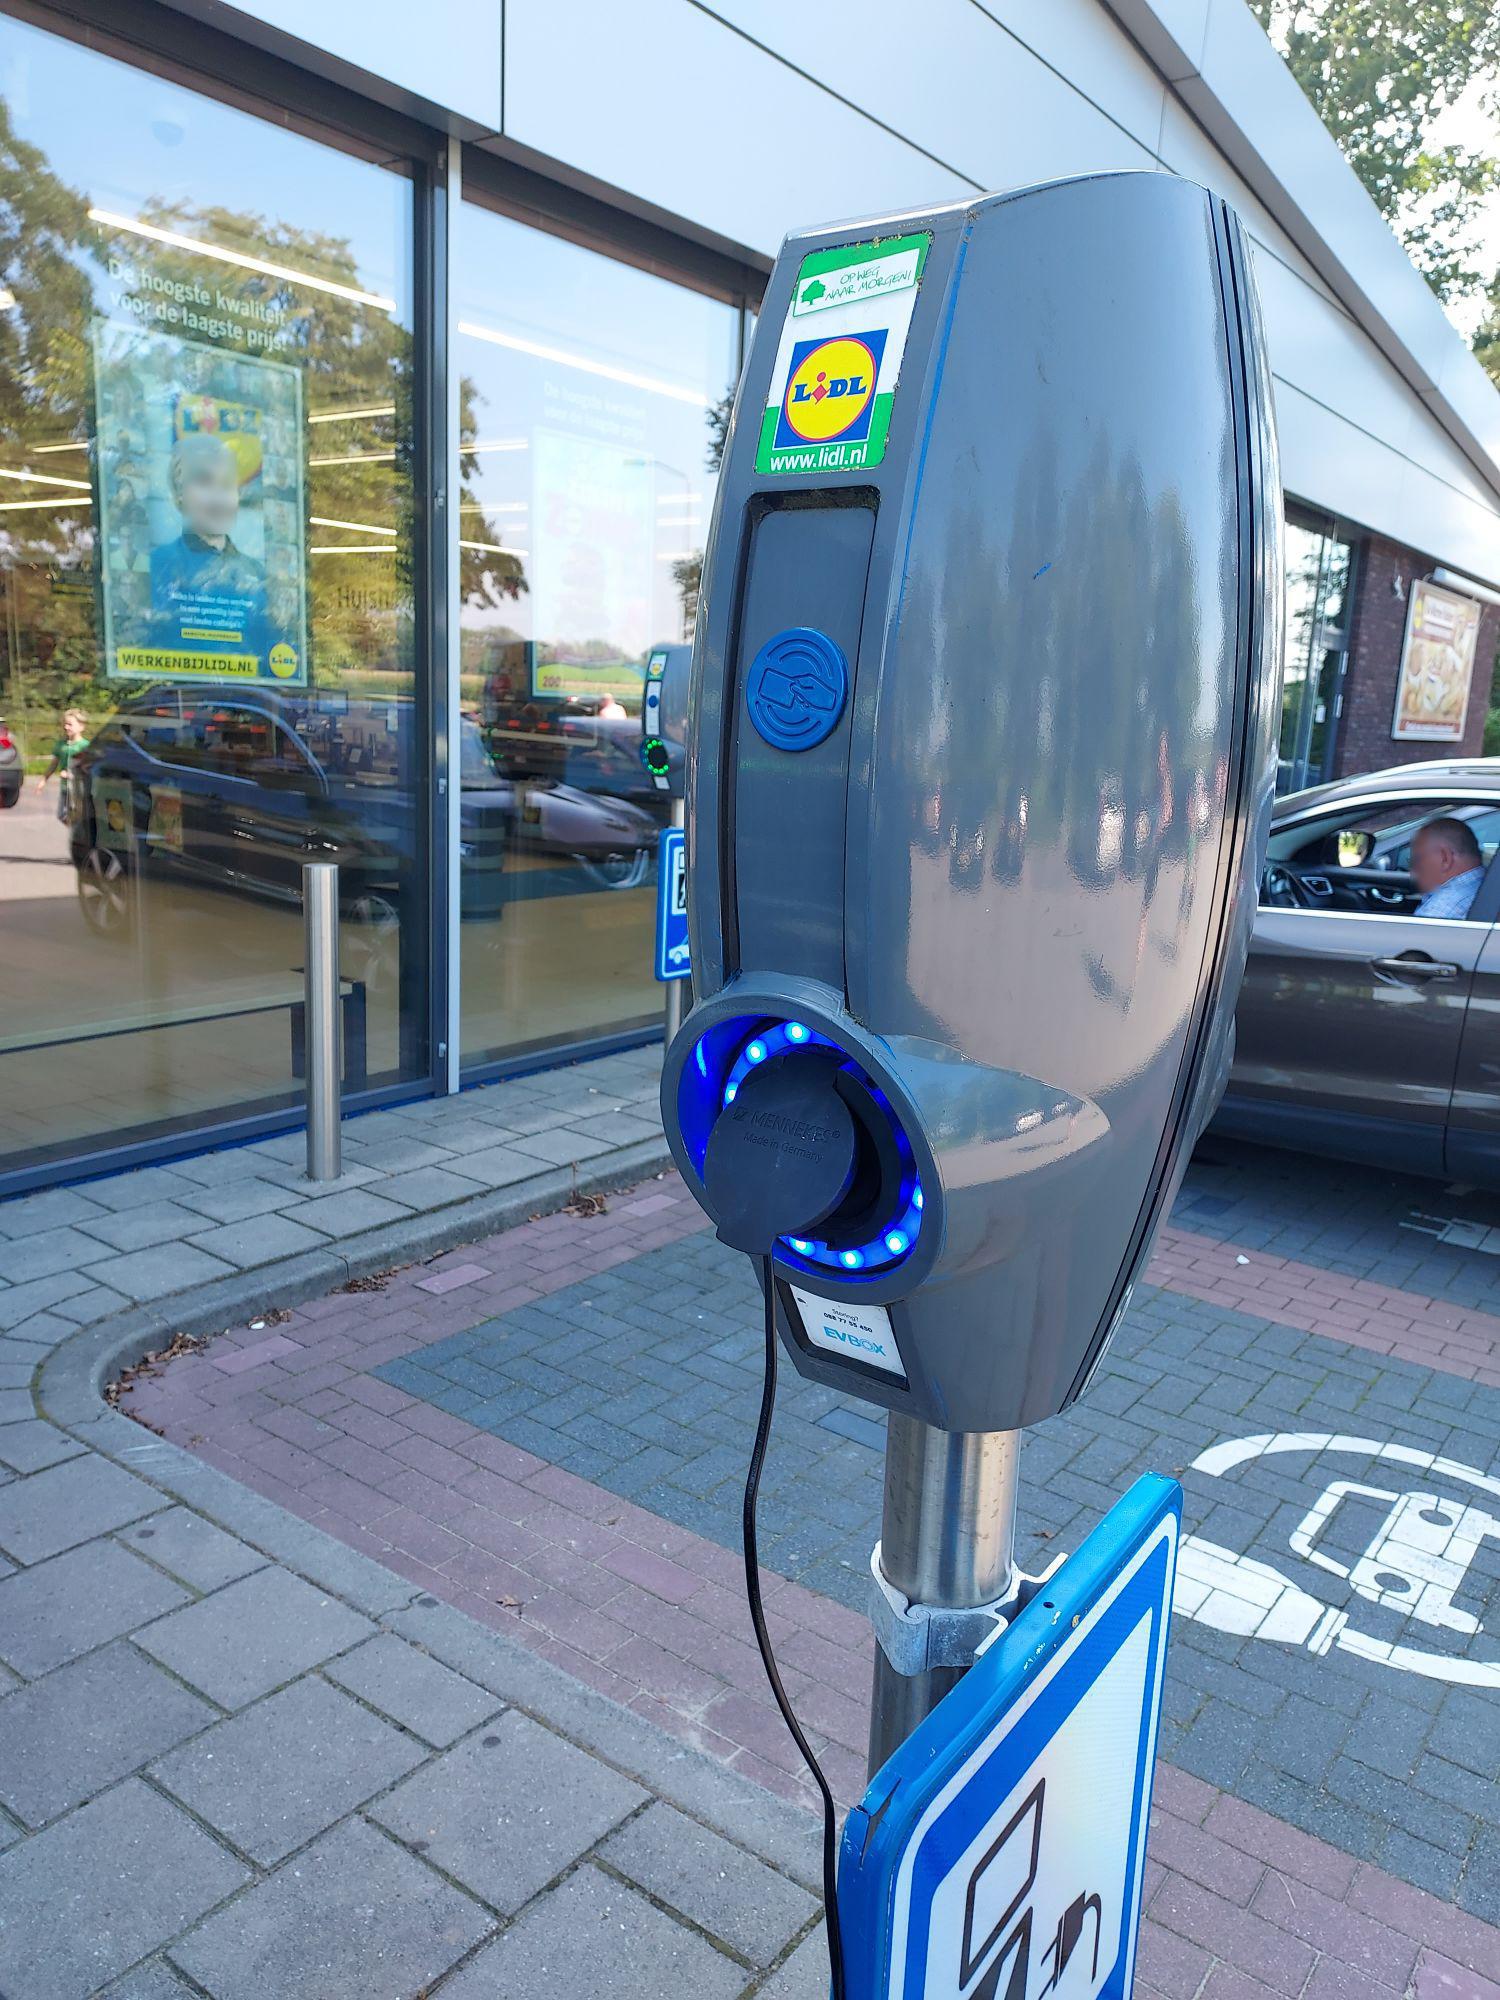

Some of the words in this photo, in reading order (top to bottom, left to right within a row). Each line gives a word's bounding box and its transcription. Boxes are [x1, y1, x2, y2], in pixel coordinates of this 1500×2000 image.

[108, 259, 134, 284] De
[141, 268, 211, 306] hoogste
[840, 273, 856, 285] OP
[857, 265, 881, 281] WEG
[825, 284, 857, 301] NAAR
[111, 292, 150, 316] voor
[156, 301, 178, 323] de
[182, 308, 243, 339] laagste
[770, 443, 868, 471] www.lidl.nl
[121, 653, 254, 672] WERKENBIJLIDL.NL
[744, 1131, 769, 1147] Made
[769, 1138, 779, 1149] in
[781, 1142, 825, 1164] Germany
